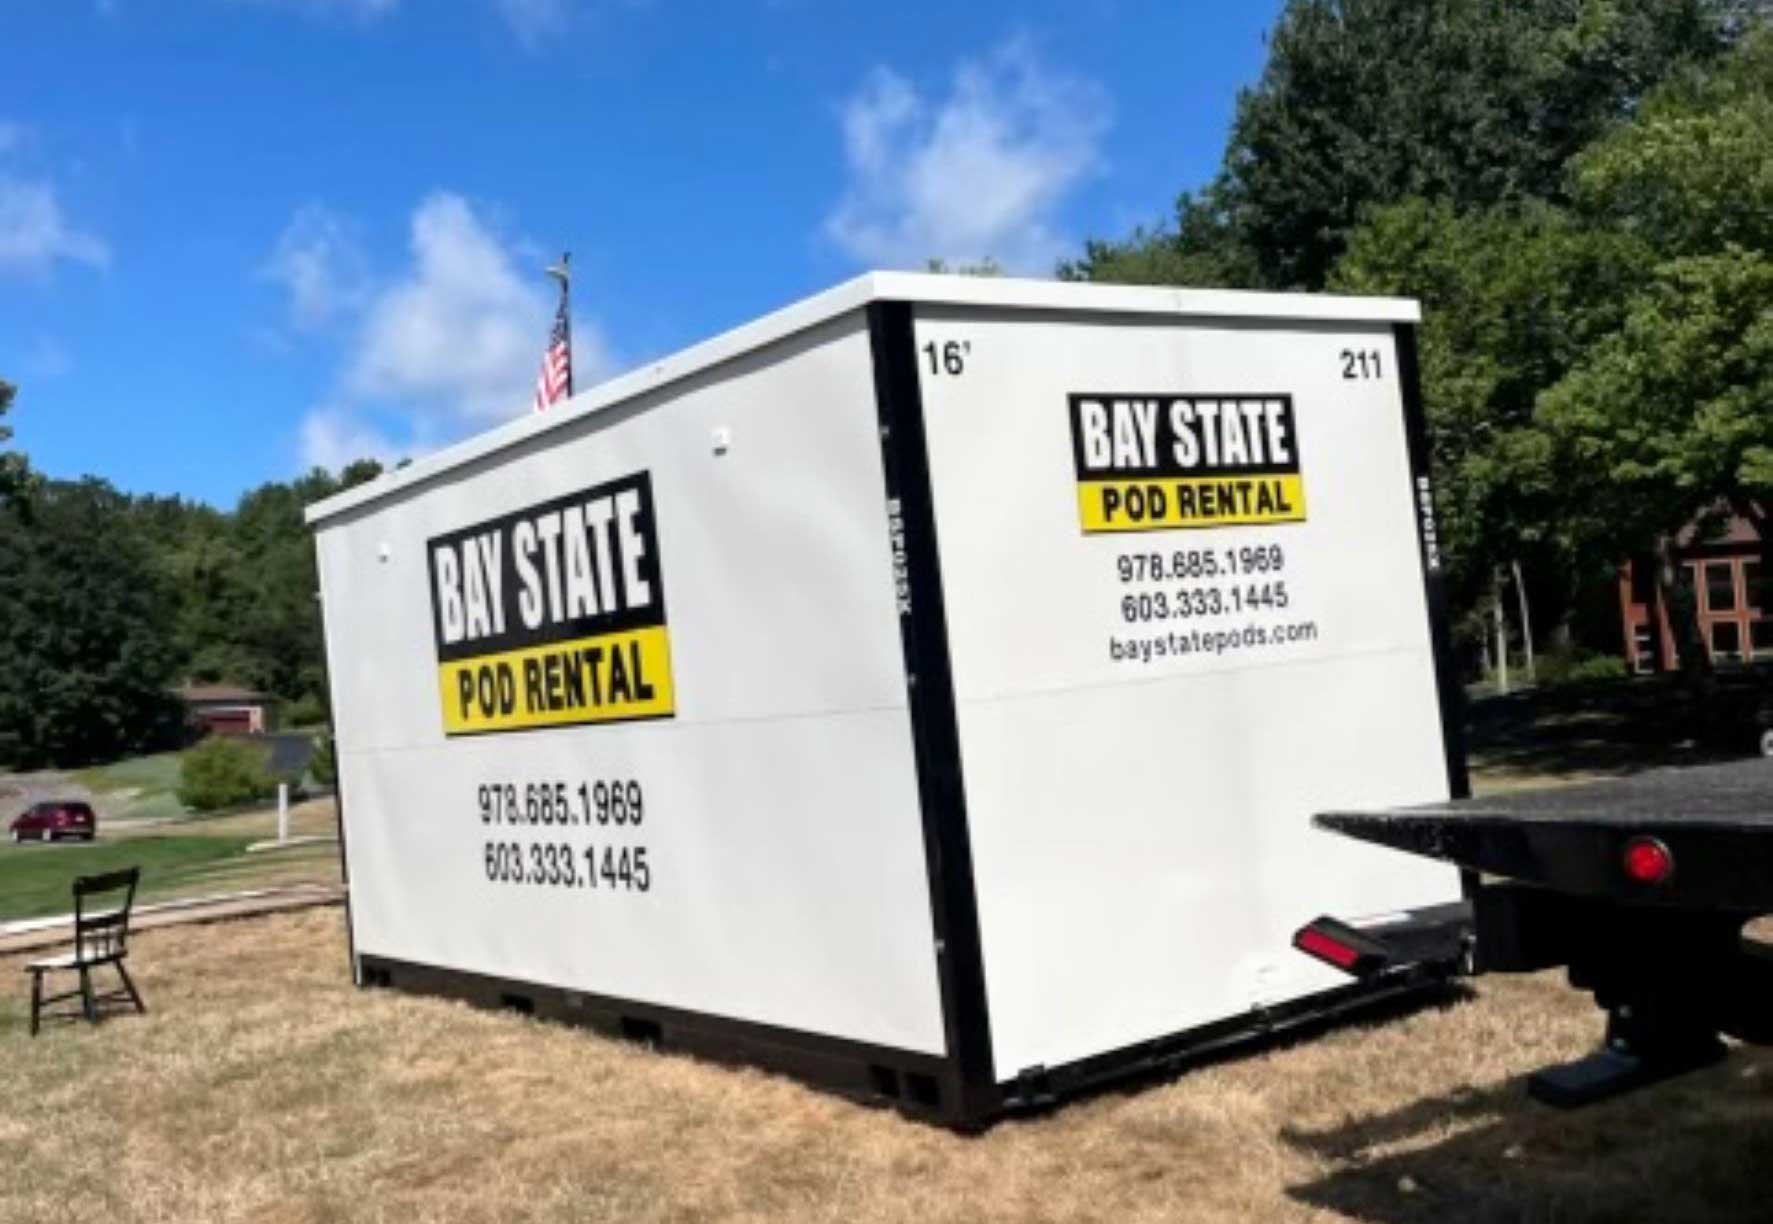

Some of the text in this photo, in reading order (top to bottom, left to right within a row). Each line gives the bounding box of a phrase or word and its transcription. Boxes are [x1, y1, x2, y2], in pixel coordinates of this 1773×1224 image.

[1339, 347, 1382, 380] 211
[1079, 398, 1292, 470] BAY STATE
[1102, 479, 1292, 523] POD RENTAL
[434, 487, 651, 645] BAY STATE
[1117, 543, 1285, 583] 978.685.1969
[1121, 580, 1289, 623] 603.333.1445
[1109, 620, 1318, 663] baystatepods.com
[457, 640, 655, 720] POD RENTAL
[477, 779, 643, 827] 978.685.1969
[484, 841, 651, 893] 603.333.1445
